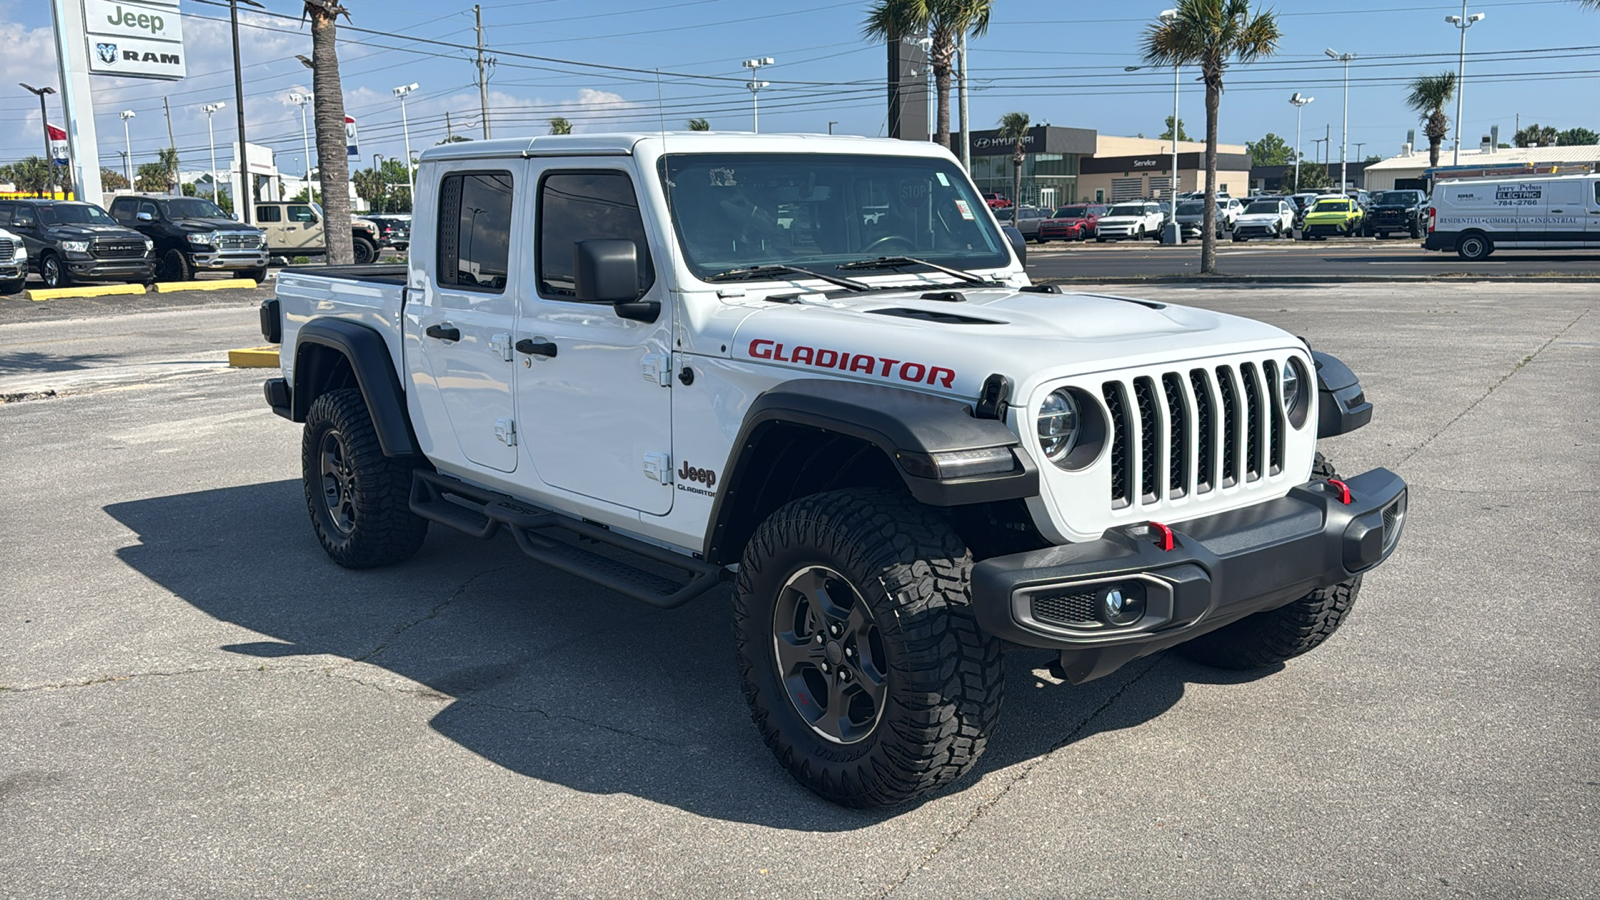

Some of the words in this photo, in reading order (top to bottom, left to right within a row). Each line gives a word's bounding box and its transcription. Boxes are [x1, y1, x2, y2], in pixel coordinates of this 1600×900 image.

[107, 5, 164, 34] Jeep
[122, 50, 180, 65] RAM
[1133, 159, 1157, 168] Service
[902, 185, 926, 199] STOP
[748, 338, 956, 389] GLADIATOR
[677, 460, 717, 489] Jeep
